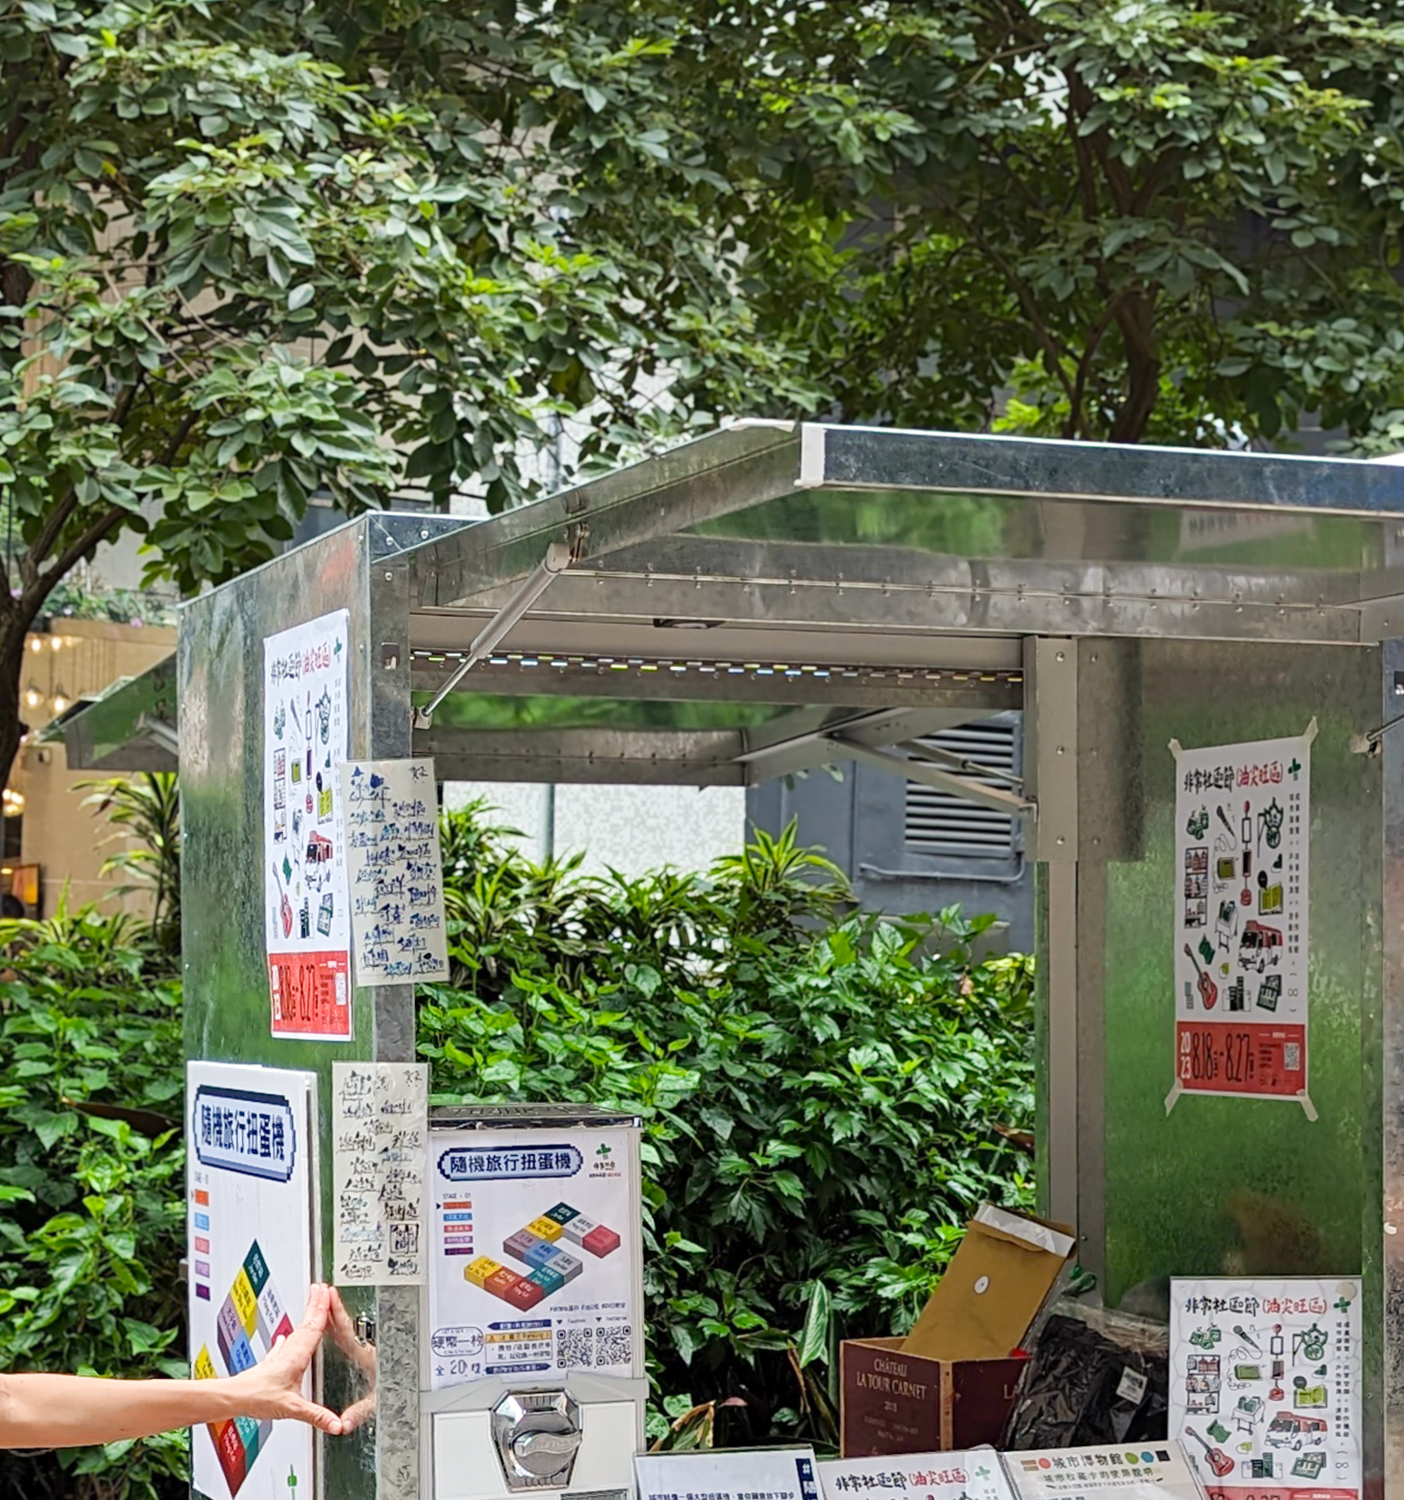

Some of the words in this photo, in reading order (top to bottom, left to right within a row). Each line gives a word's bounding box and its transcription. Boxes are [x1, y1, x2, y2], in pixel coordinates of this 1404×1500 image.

[202, 1104, 285, 1161] 隨機旅行扭蛋機
[451, 1153, 571, 1173] 隨機旅行扭蛋機
